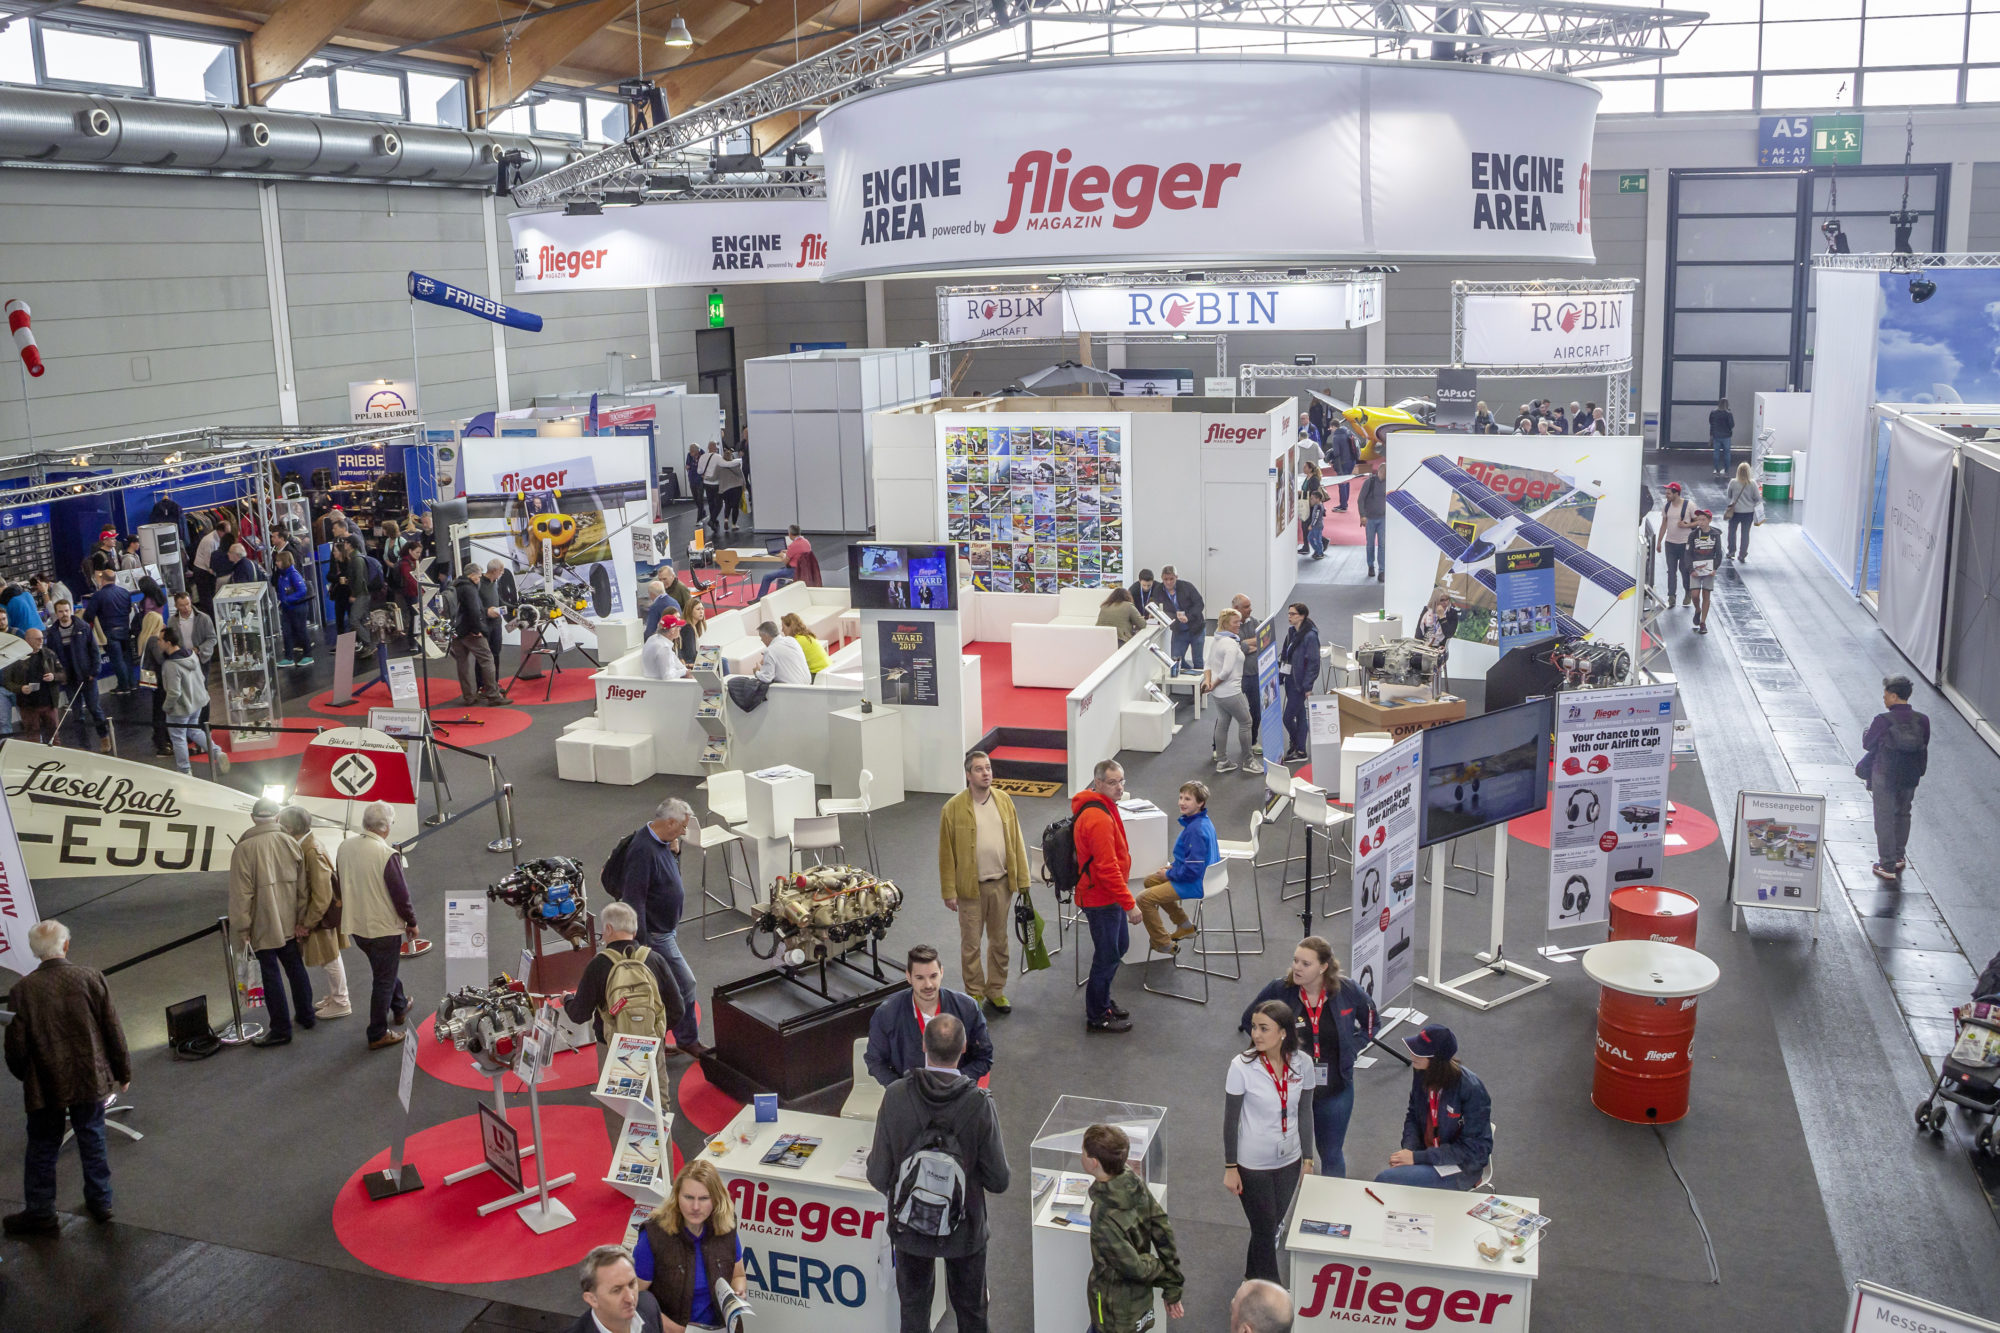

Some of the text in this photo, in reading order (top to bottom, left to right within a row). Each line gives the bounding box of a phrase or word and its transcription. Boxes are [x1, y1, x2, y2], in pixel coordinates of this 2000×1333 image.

[1772, 119, 1808, 138] A5
[1472, 152, 1564, 194] ENGINE
[862, 158, 961, 208] ENGINE
[992, 148, 1242, 234] flieger
[1473, 193, 1546, 231] AREA
[1550, 221, 1570, 233] powered
[860, 203, 986, 246] AREA powered by
[1026, 216, 1102, 230] MAGAZIN
[712, 234, 782, 252] ENGINE
[537, 245, 608, 280] flieger
[712, 252, 764, 270] AREA
[444, 286, 506, 319] FRIEBE
[967, 297, 1044, 320] ROBIN
[1128, 291, 1279, 328] ROBIN
[1530, 300, 1622, 334] ROBIN
[980, 326, 1028, 337] AIRCRAFT
[1554, 344, 1610, 358] AIRCRAFT
[1437, 390, 1468, 398] CAP10
[355, 410, 418, 420] PPL/IR EUROPE
[1204, 423, 1266, 444] flieger
[338, 454, 384, 468] FRIEBE
[914, 577, 943, 585] AWARD
[892, 634, 923, 642] AWARD
[606, 685, 646, 700] flieger
[1593, 709, 1622, 720] flieger
[1572, 726, 1659, 743] Your chance to win
[1569, 736, 1661, 754] with our Airlift Cap!
[5, 761, 182, 817] Liesel Bach
[1752, 800, 1814, 812] Messeangebot
[1650, 934, 1678, 942] flieger
[1644, 1050, 1678, 1062] flieger
[727, 1178, 885, 1243] flieger
[740, 1222, 794, 1238] MAGAZIN
[742, 1246, 867, 1308] AERO
[748, 1290, 811, 1308] ERNATIONAL
[1298, 1262, 1513, 1331] flieger
[1330, 1310, 1396, 1327] MAGAZIN
